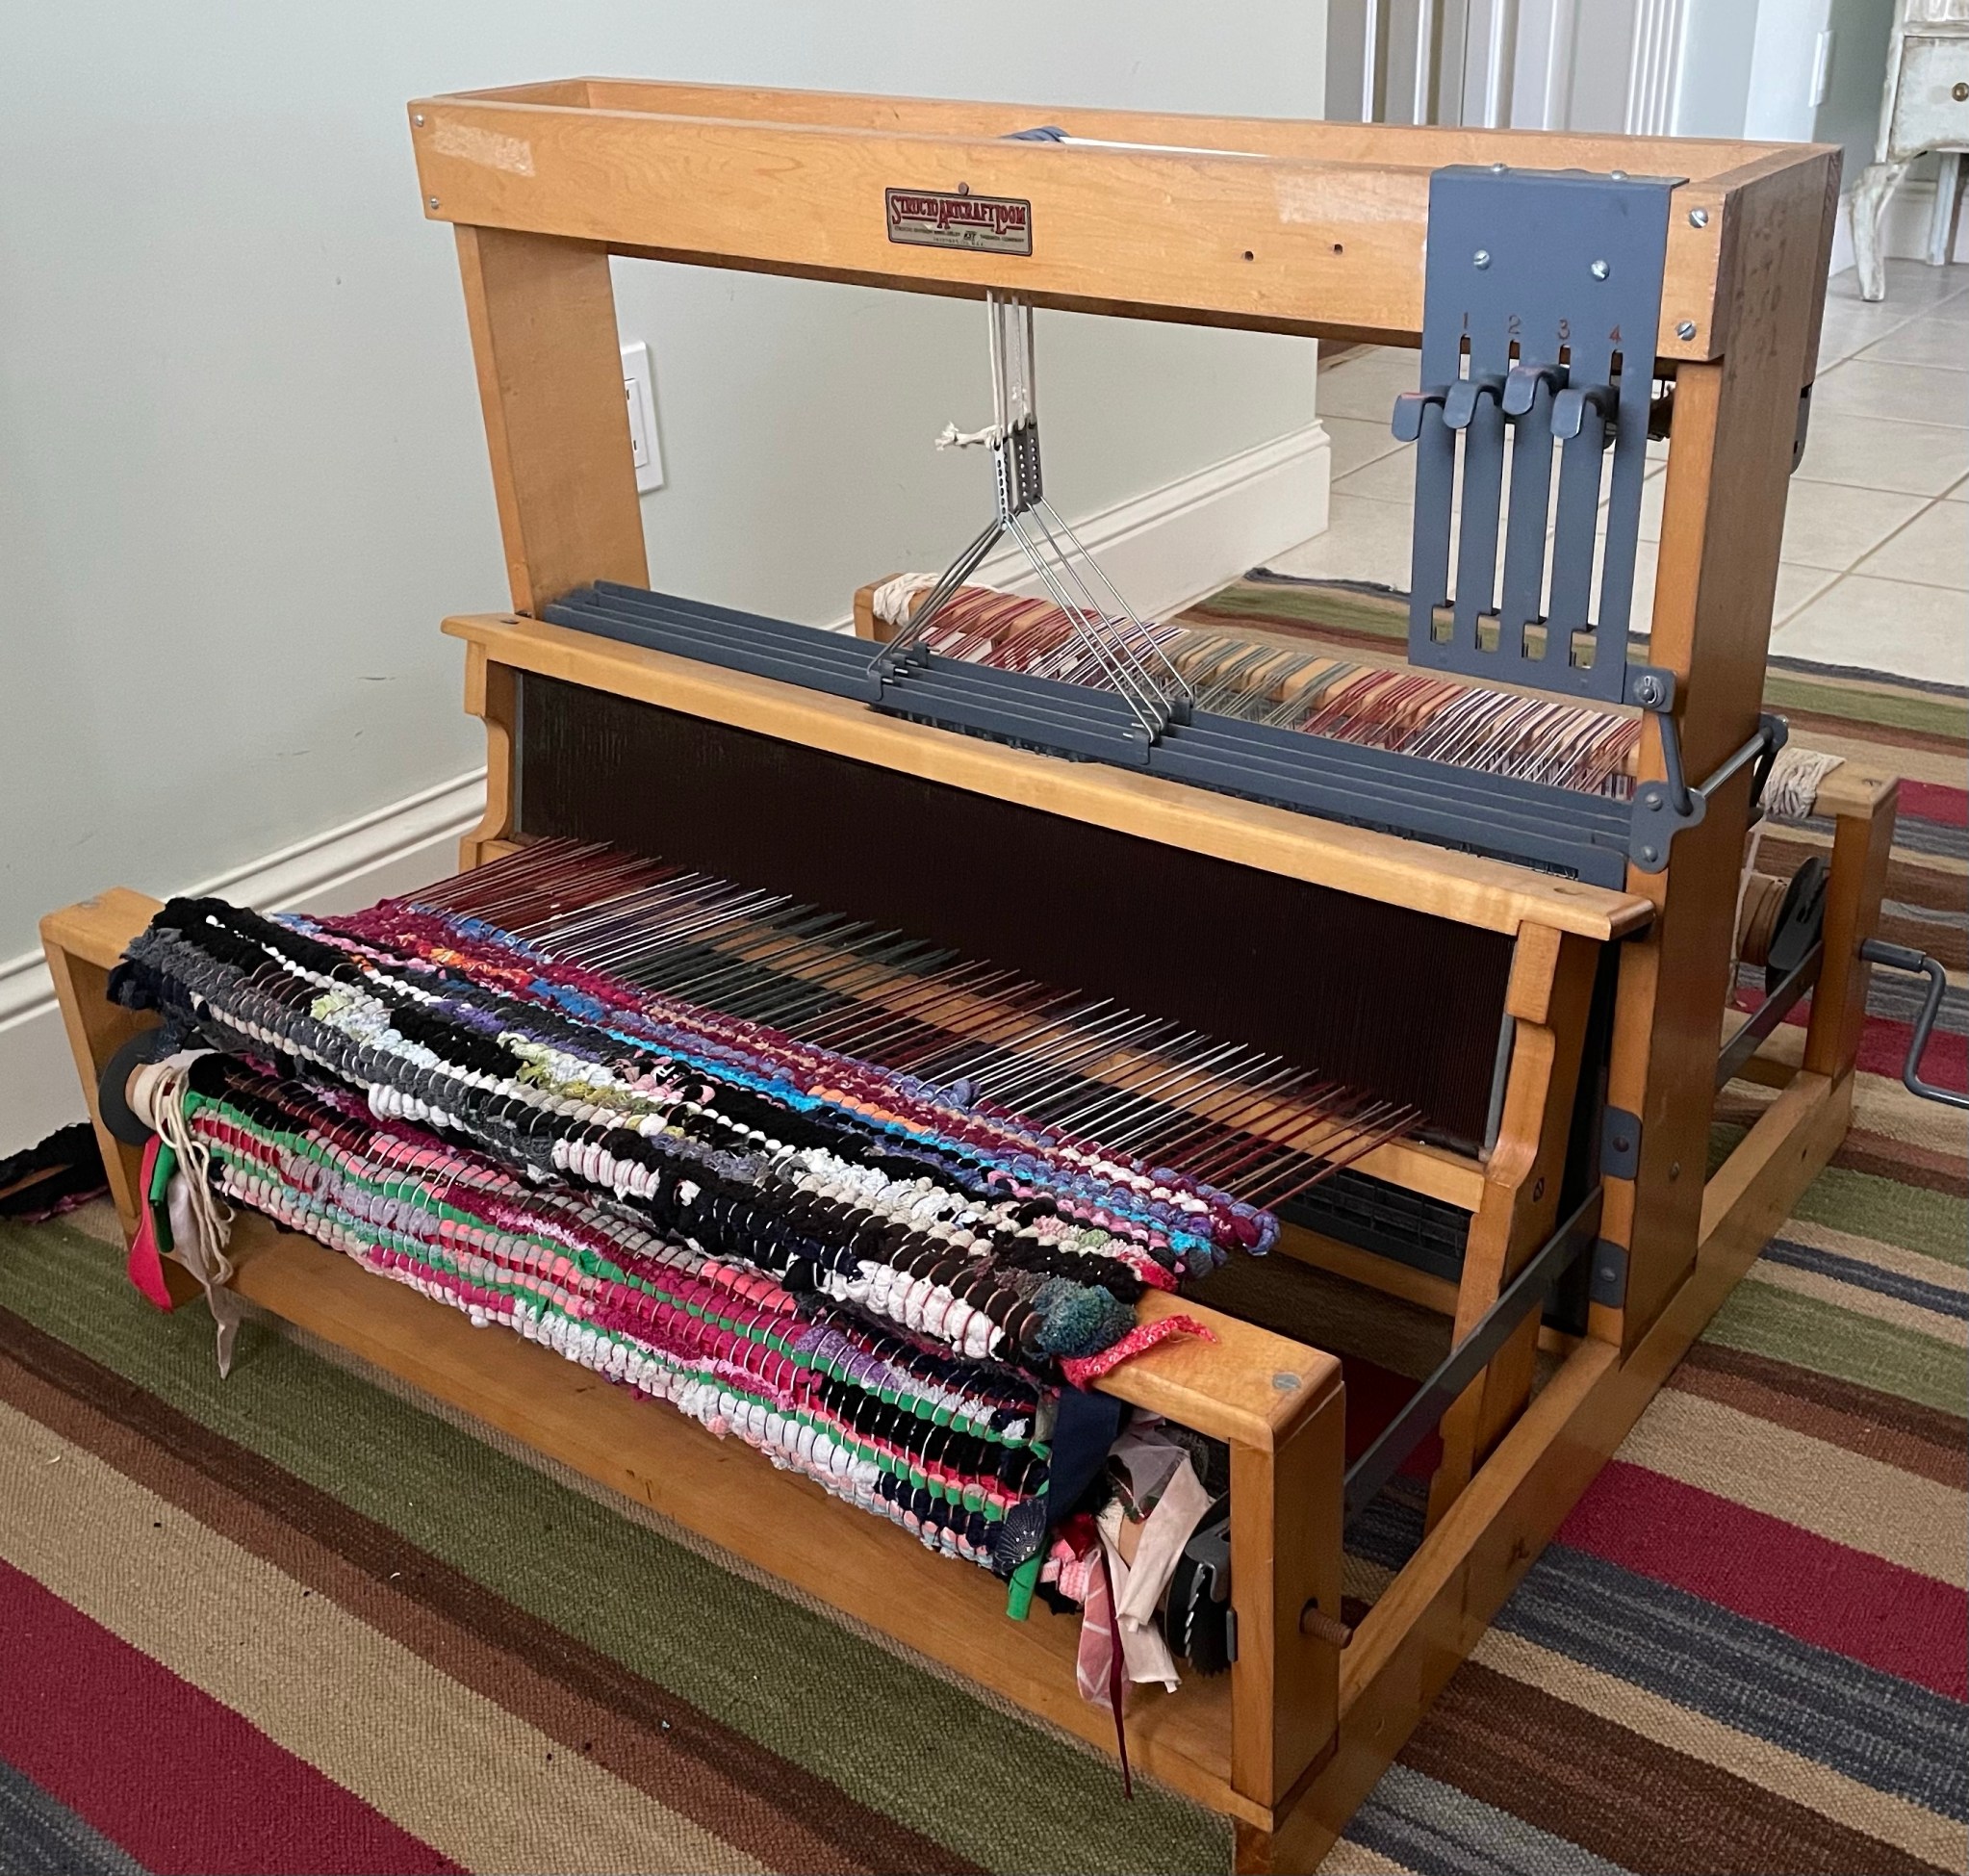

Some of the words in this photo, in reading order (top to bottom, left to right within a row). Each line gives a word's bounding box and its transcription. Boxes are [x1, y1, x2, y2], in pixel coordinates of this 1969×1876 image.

[891, 195, 938, 224] STRUCTO
[937, 199, 994, 229] ARTCRAFT
[994, 204, 1026, 234] LOOM
[1463, 312, 1469, 329] 1
[1507, 314, 1521, 335] 2
[1557, 317, 1571, 340] 3
[1608, 323, 1623, 345] 4
